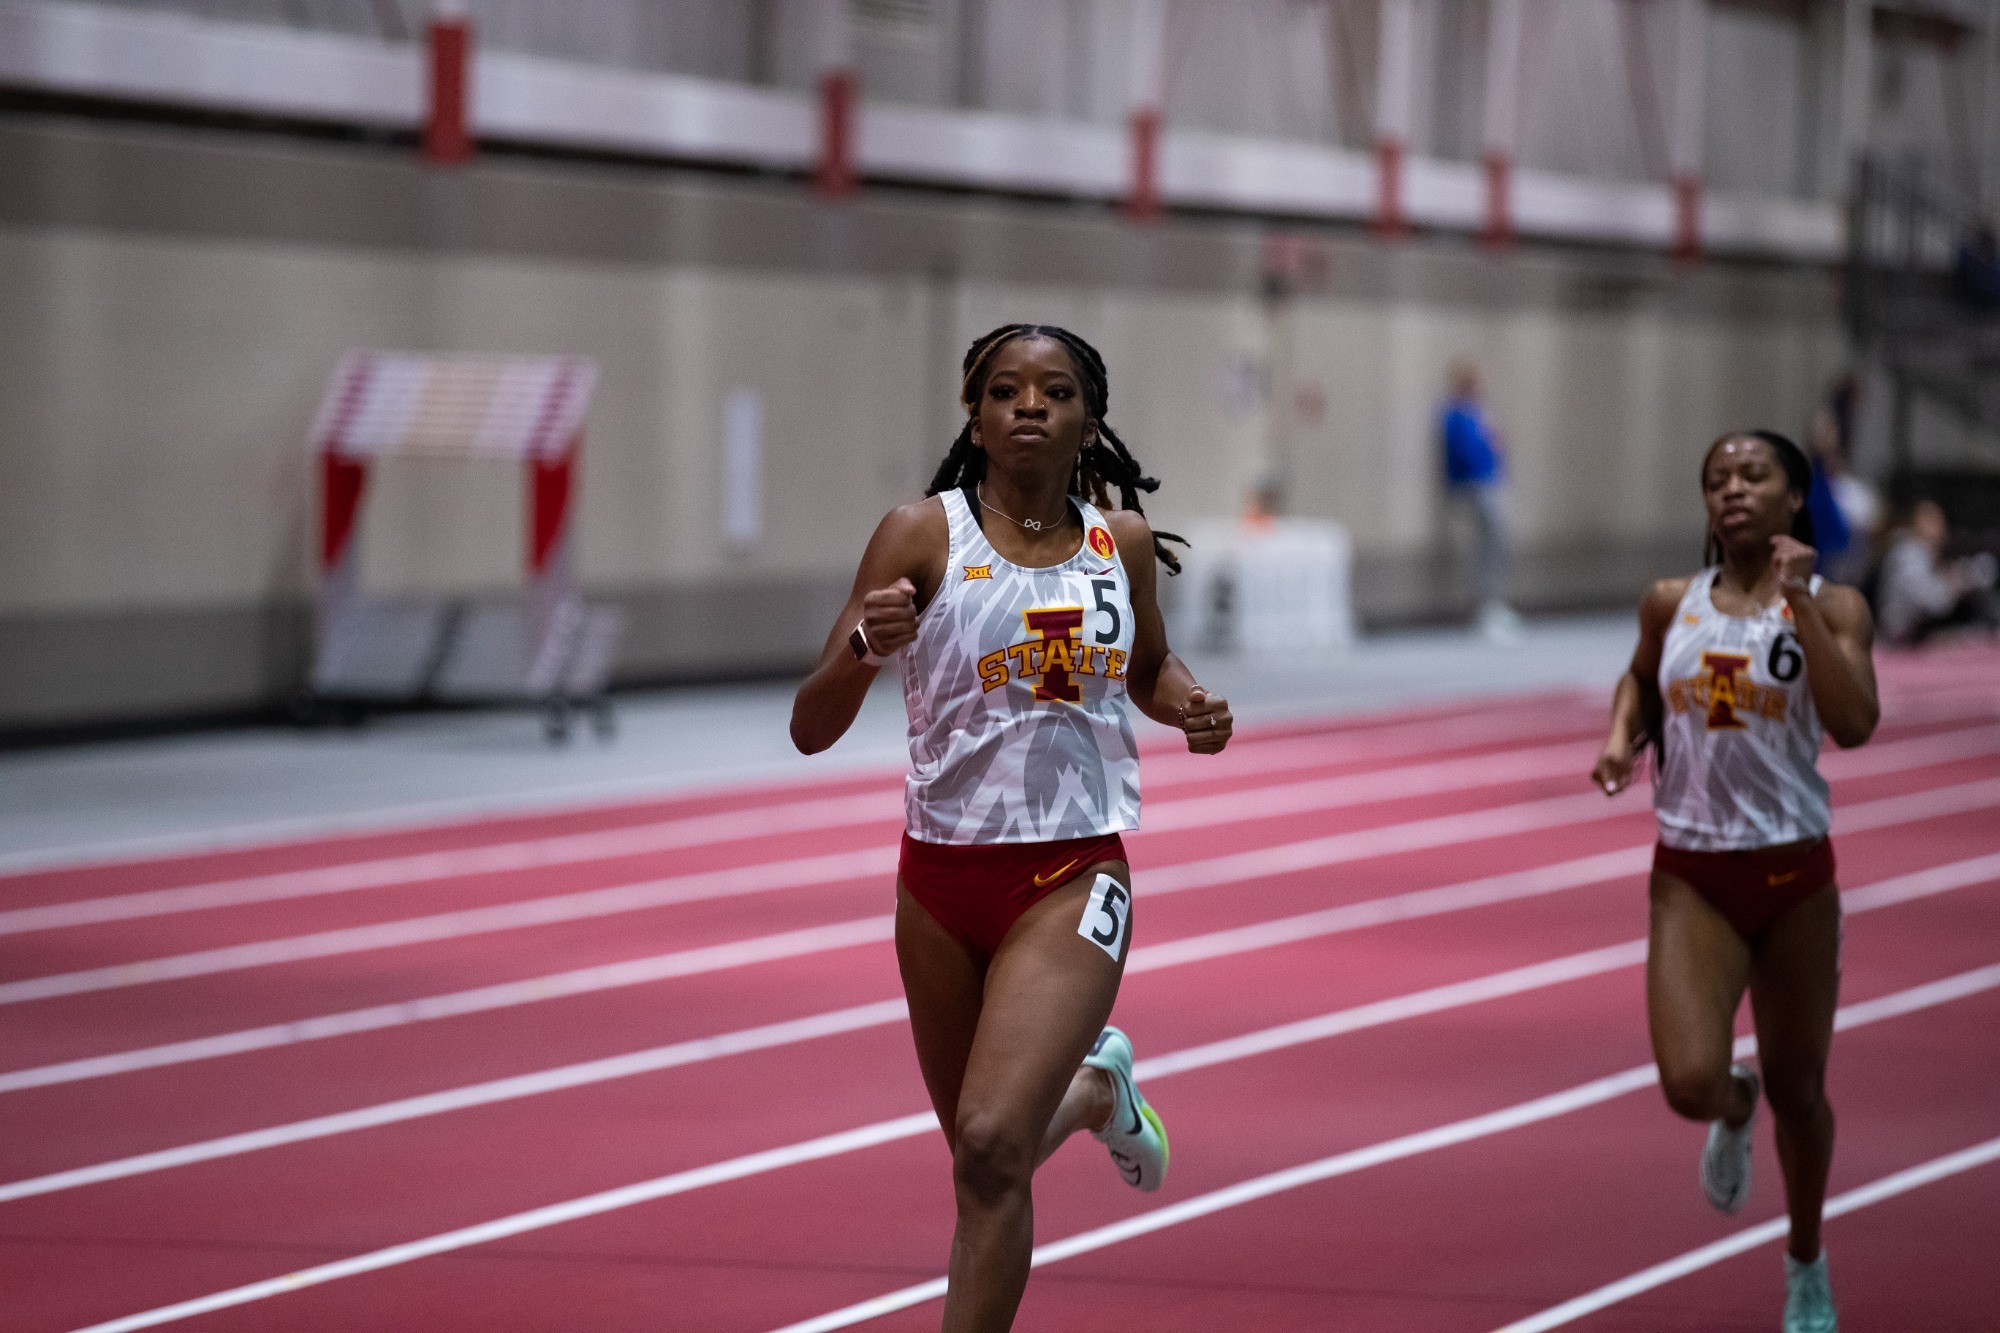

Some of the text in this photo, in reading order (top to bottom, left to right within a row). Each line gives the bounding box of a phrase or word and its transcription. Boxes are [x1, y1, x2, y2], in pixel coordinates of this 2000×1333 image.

[1090, 579, 1121, 645] 5
[977, 636, 1127, 694] STATE
[1768, 632, 1803, 683] 6
[1091, 882, 1127, 946] 5
